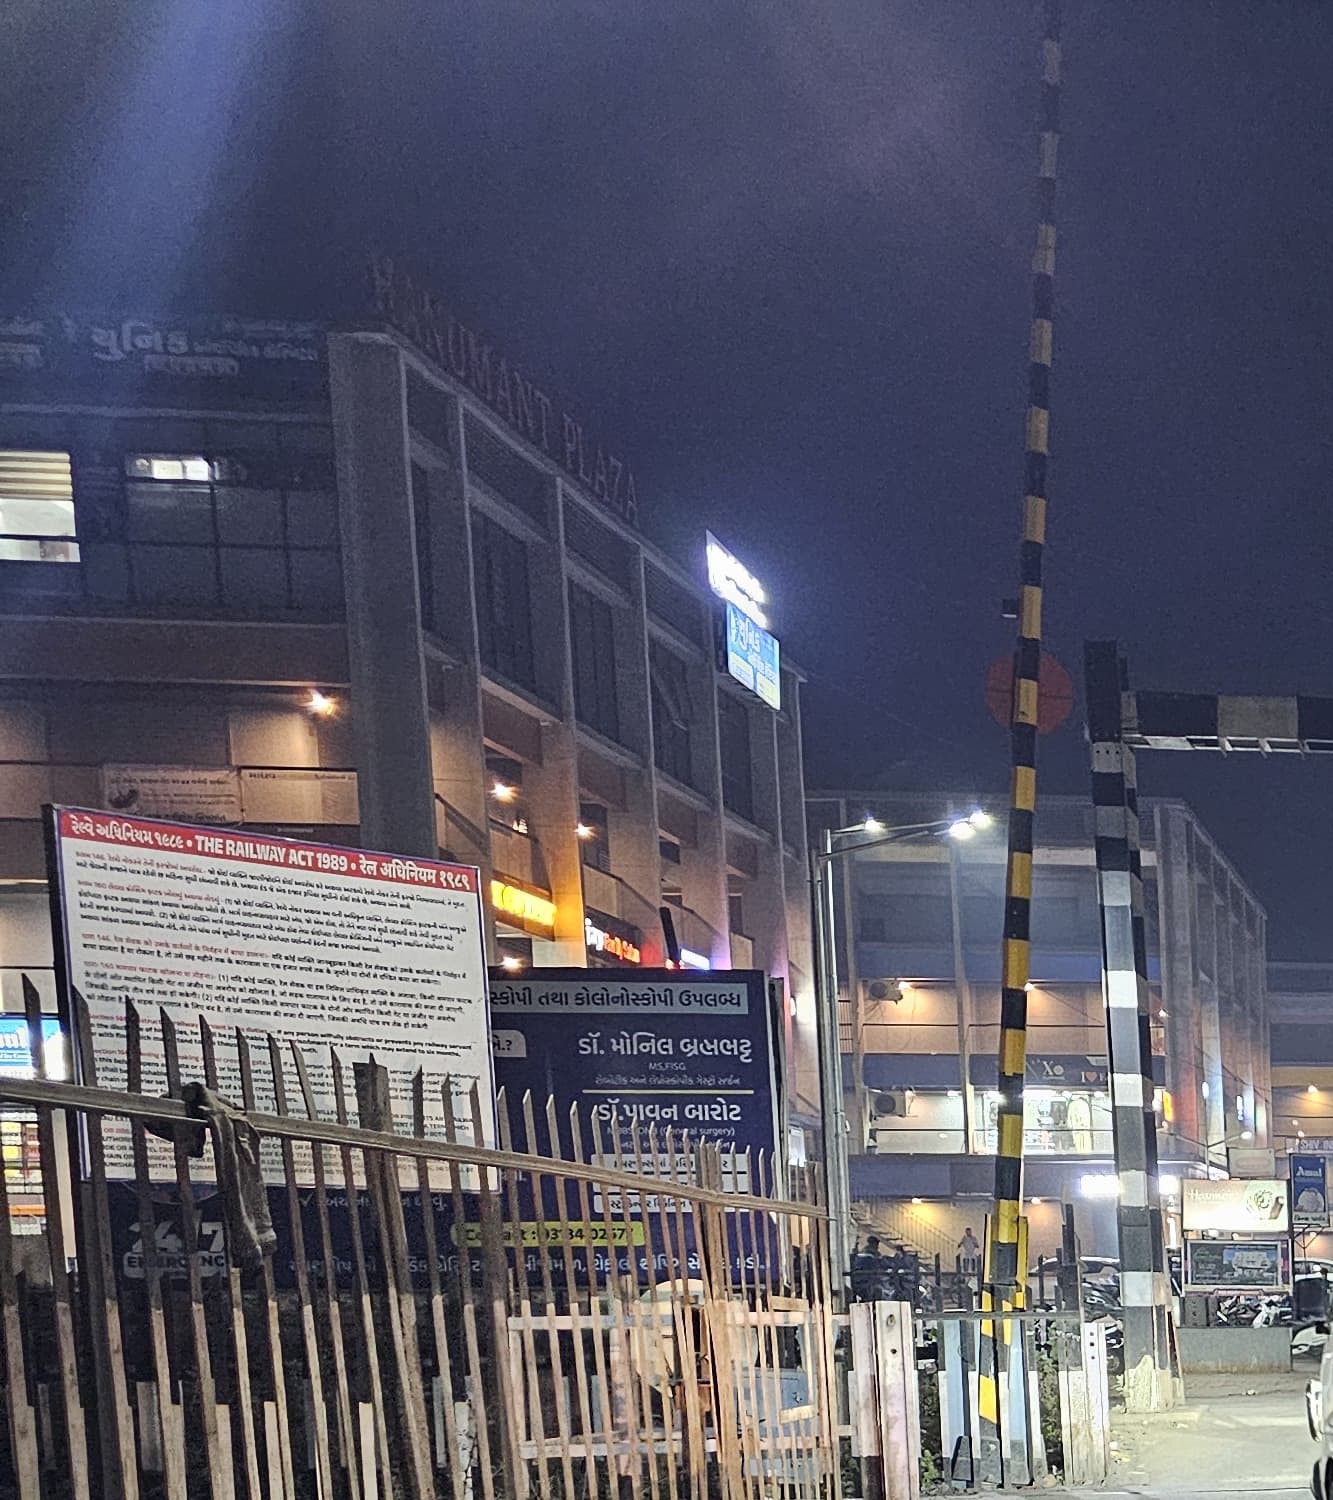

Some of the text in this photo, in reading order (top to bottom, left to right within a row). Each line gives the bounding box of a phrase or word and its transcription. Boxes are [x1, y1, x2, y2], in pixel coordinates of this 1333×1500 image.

[96, 820, 154, 845] અધિનિયમ
[195, 835, 348, 872] THE RAILWAY ACT 1989
[359, 854, 471, 890] रेल अधिनियम १९८९
[538, 990, 569, 1007] તથા
[574, 987, 674, 1007] કોલોનોસ્કોપી
[679, 989, 741, 1008] ઉપલબ્ધ
[578, 1031, 605, 1056] ડૉ.
[610, 1030, 673, 1056] મોનિલ
[684, 1097, 742, 1121] બારોટ
[1296, 1166, 1322, 1178] Amul
